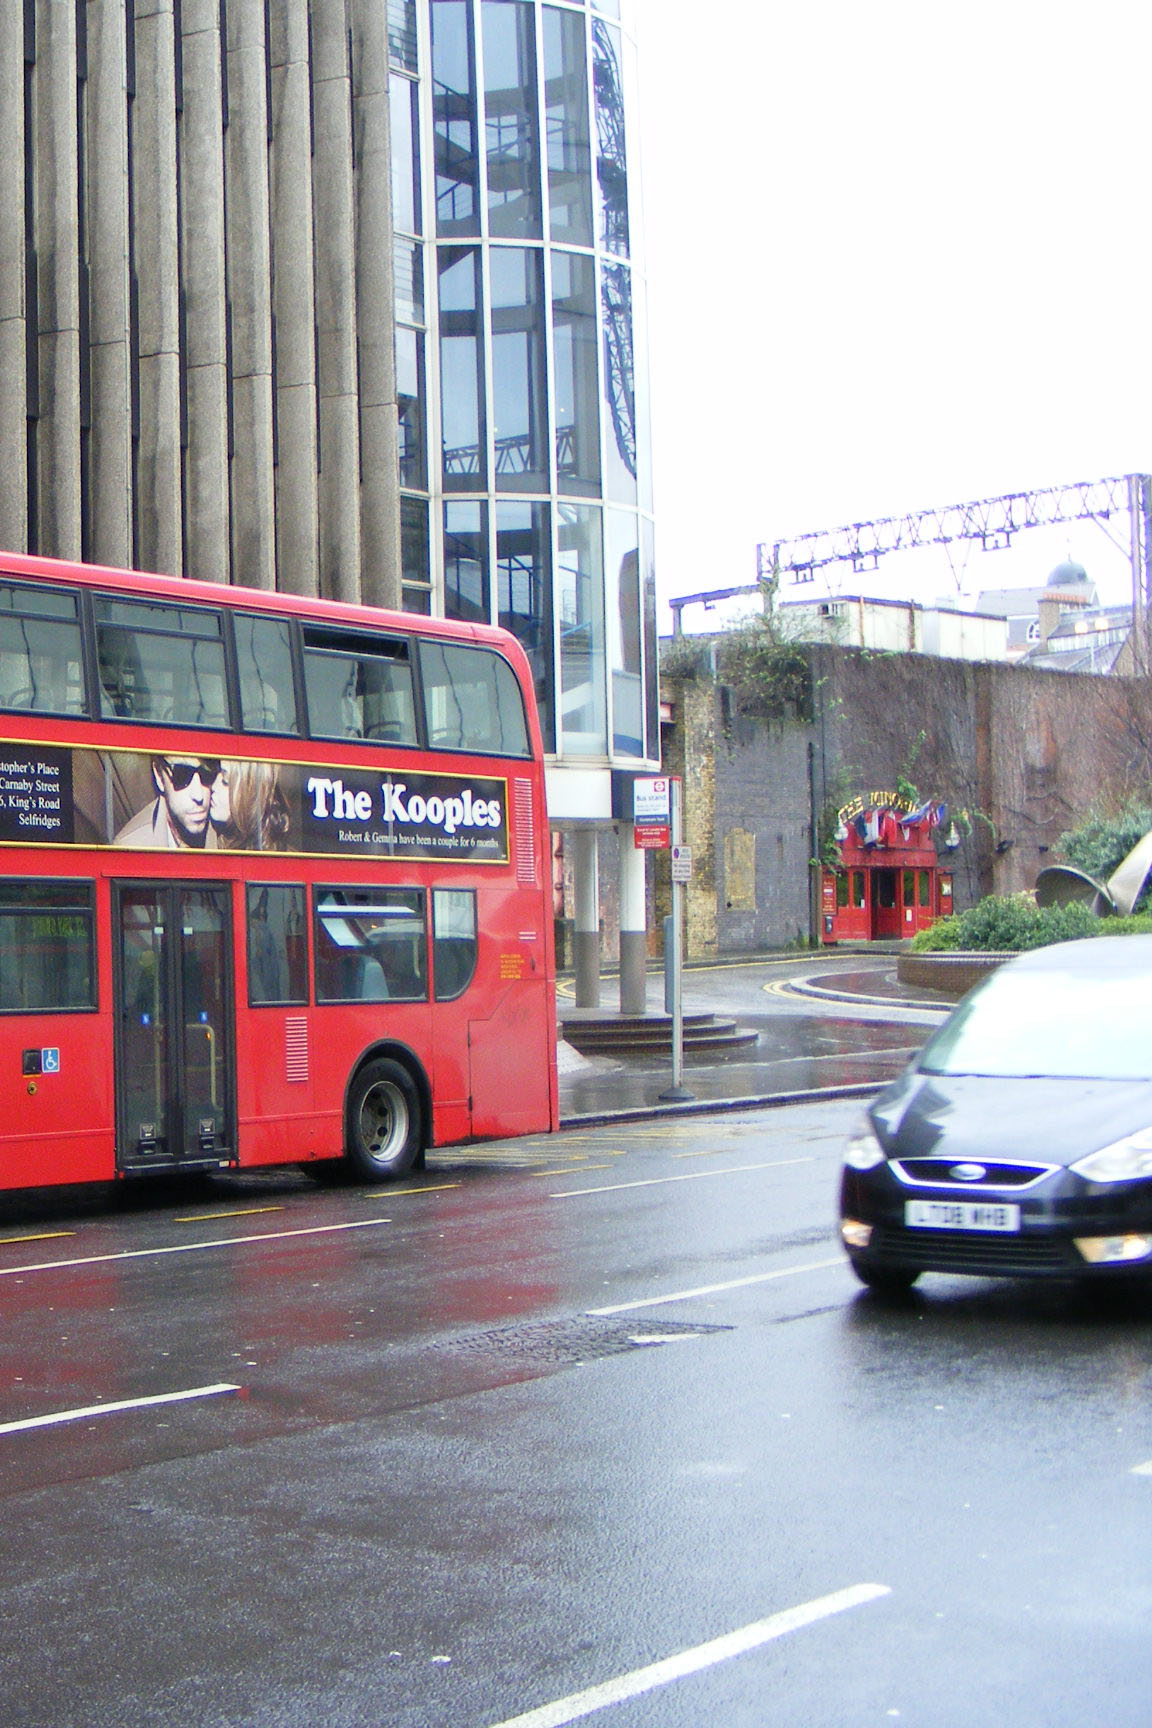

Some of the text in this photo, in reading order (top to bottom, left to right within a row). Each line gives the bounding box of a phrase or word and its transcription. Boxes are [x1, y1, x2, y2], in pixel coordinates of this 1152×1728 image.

[37, 762, 59, 776] Place
[35, 779, 60, 792] Street
[8, 795, 37, 811] King's
[38, 796, 60, 809] Road
[307, 777, 502, 834] The Kooples
[18, 812, 61, 829] Selfridges
[338, 829, 363, 842] Robert
[364, 831, 371, 843] &
[398, 832, 415, 845] have
[416, 833, 431, 845] been
[438, 835, 459, 849] couple
[459, 835, 469, 847] for
